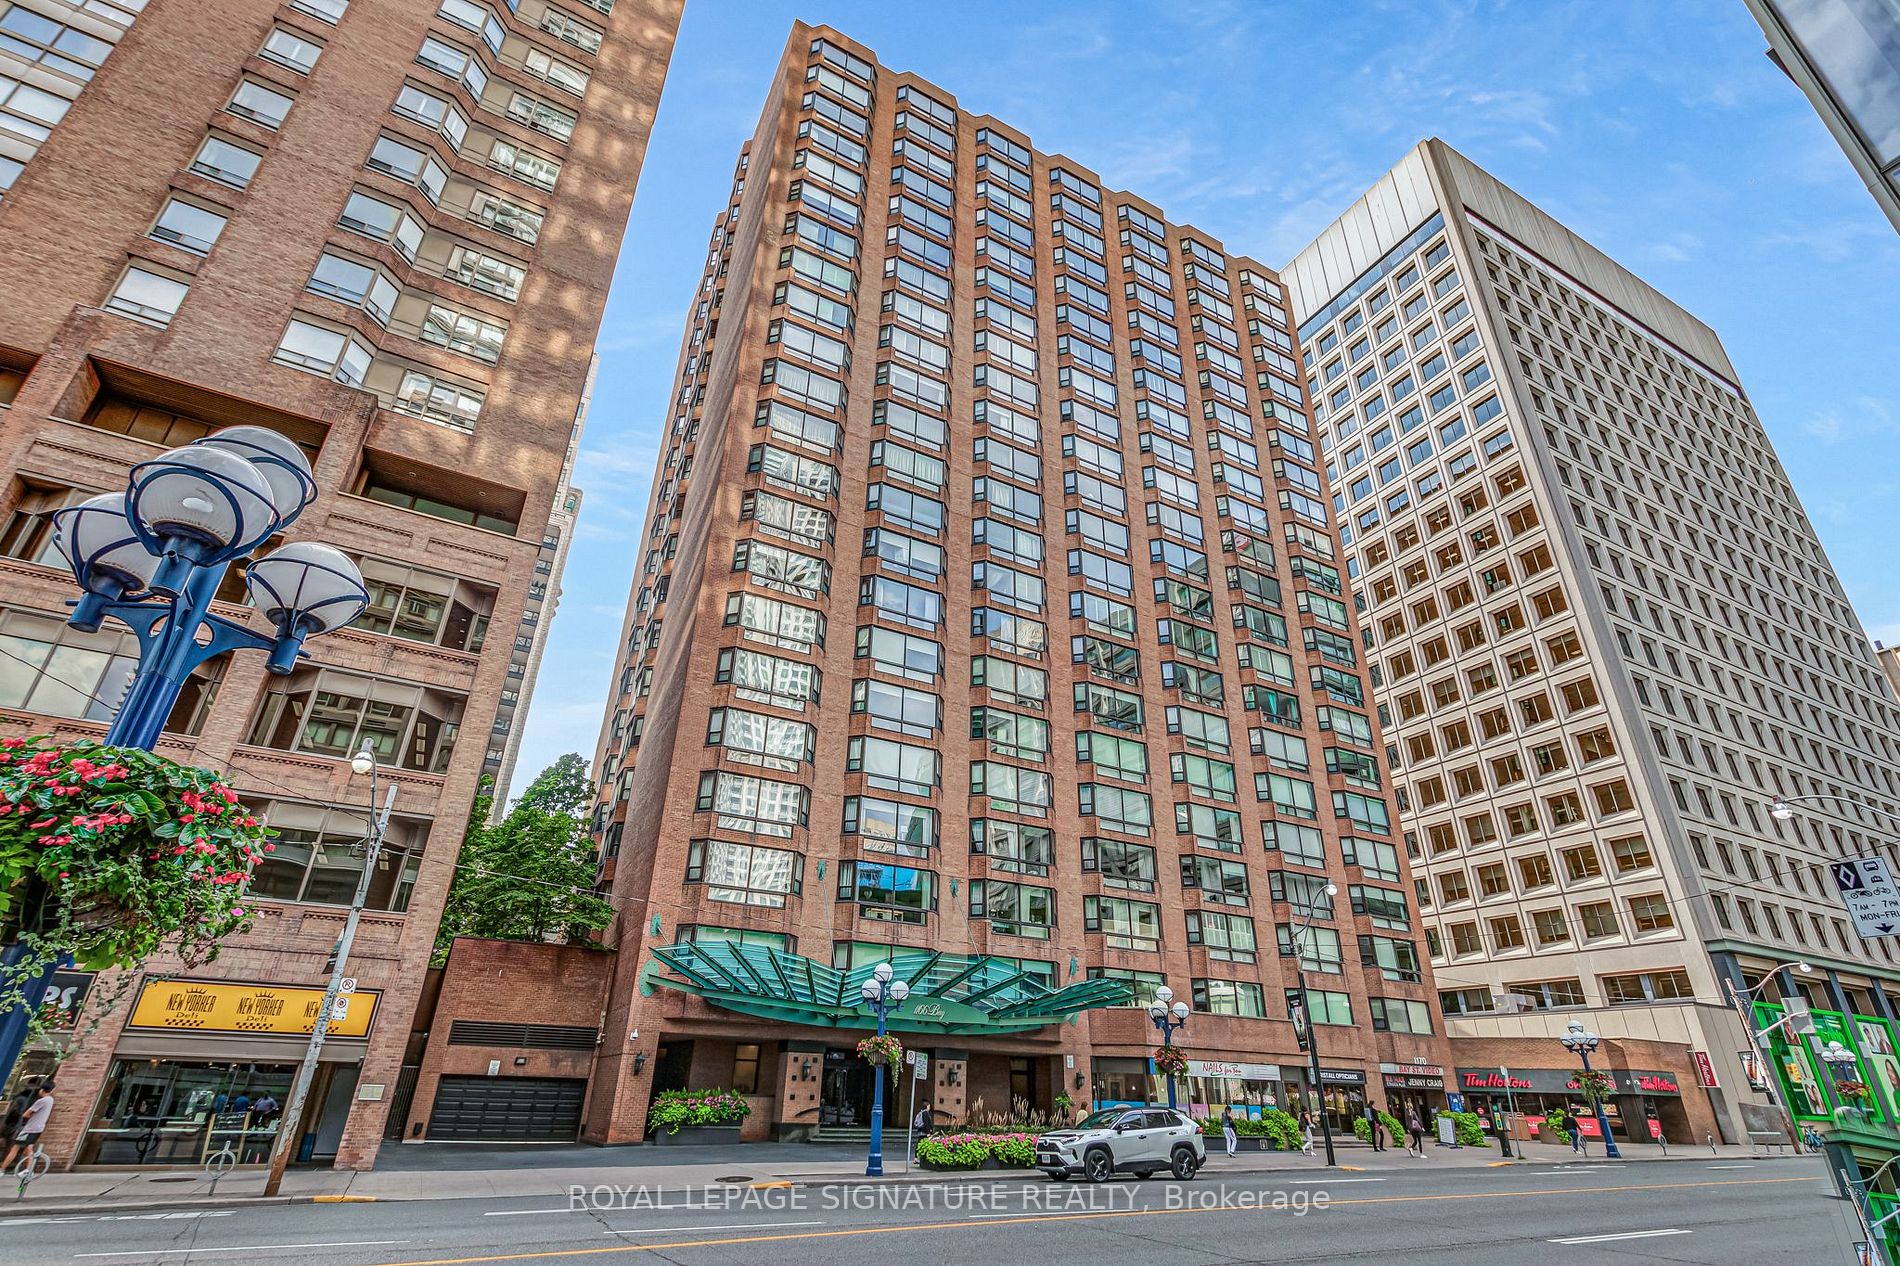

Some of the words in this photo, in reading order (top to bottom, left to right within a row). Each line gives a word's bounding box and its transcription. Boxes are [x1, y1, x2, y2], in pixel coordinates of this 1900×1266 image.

[166, 993, 185, 1011] NEW
[184, 995, 216, 1012] YORKER
[236, 997, 255, 1014] NEW
[254, 999, 284, 1016] YORKER
[304, 1001, 320, 1018] NEW
[928, 1003, 945, 1021] Bay
[1413, 1056, 1427, 1065] 1170
[1202, 1063, 1223, 1073] NAILS
[1399, 1065, 1410, 1073] BAY
[1423, 1067, 1440, 1075] VIDEO
[1408, 1079, 1426, 1087] JENNY
[1426, 1079, 1443, 1088] CRAIG
[1463, 1073, 1487, 1087] Tim
